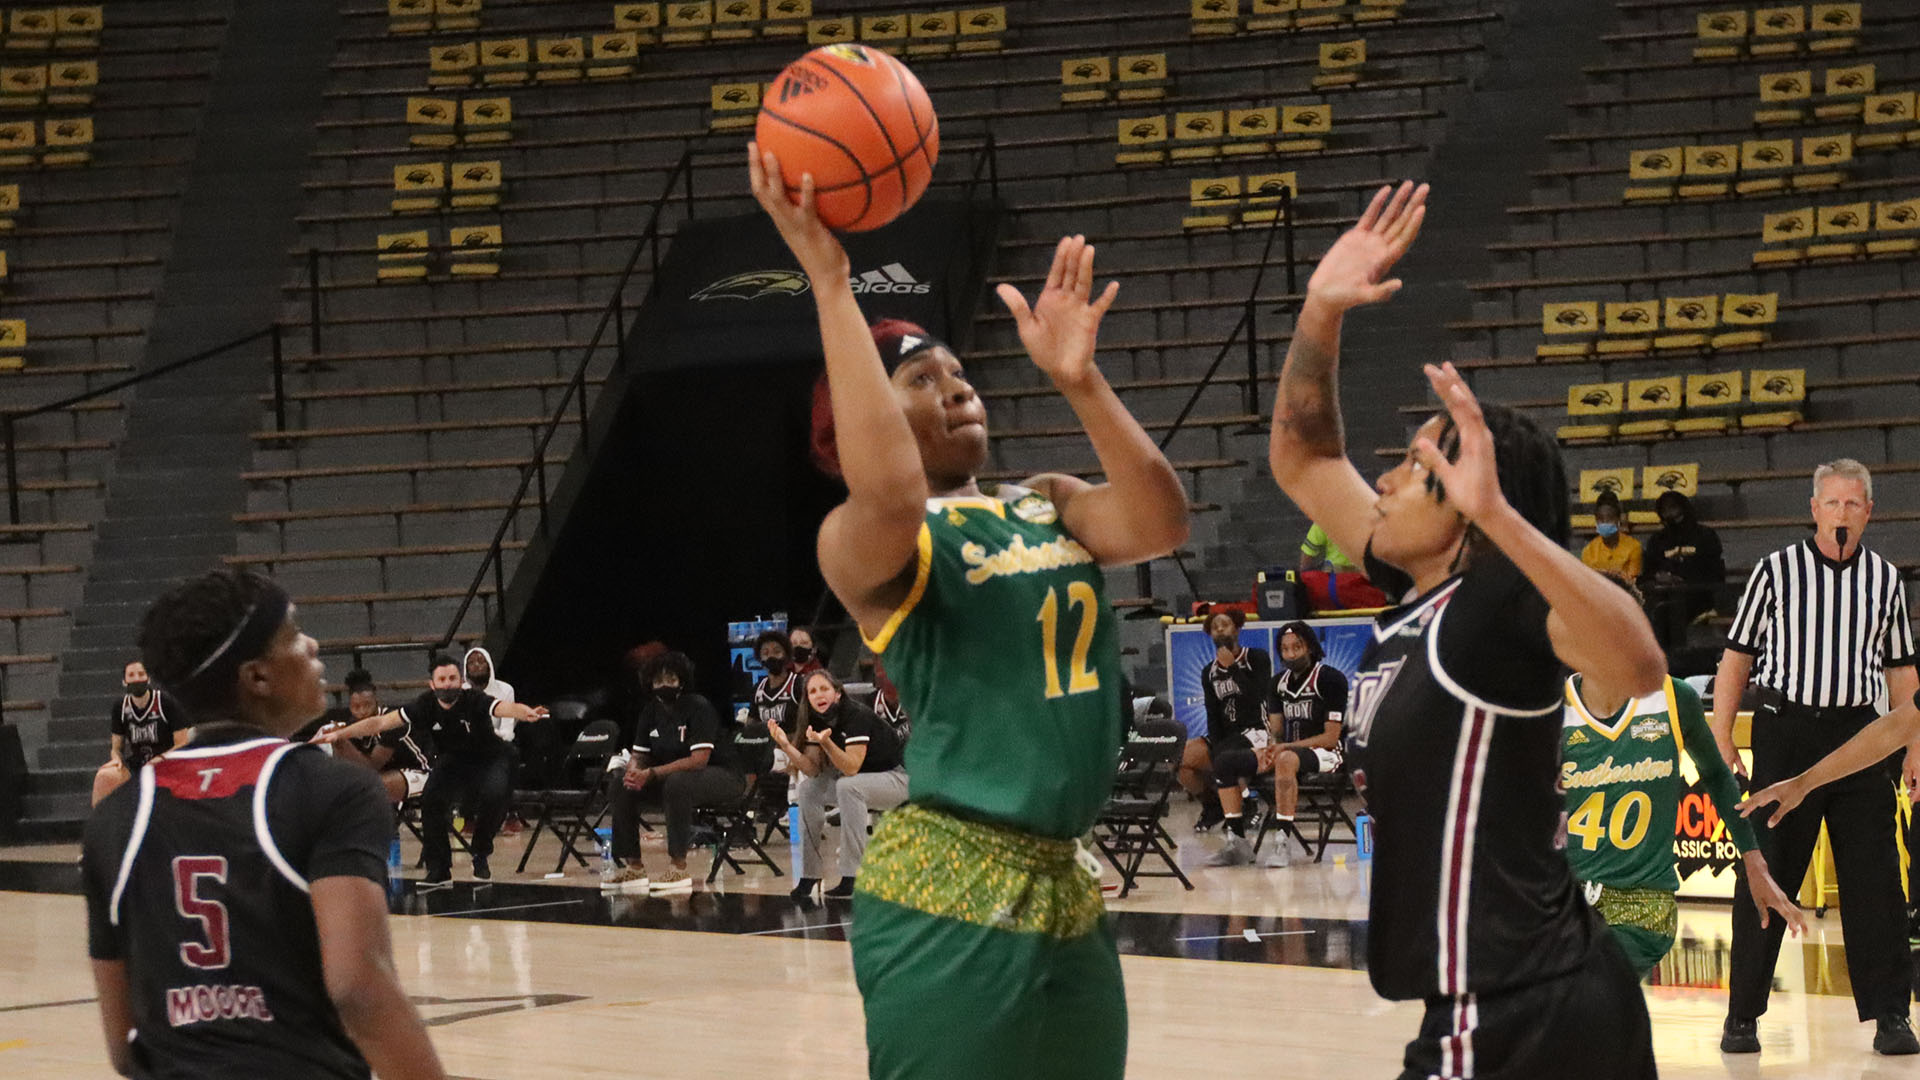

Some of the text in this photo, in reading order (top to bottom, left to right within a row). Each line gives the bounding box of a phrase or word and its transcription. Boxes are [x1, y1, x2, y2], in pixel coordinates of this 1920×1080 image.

[851, 281, 931, 294] didas
[1036, 580, 1100, 699] 12
[197, 767, 224, 792] T
[1561, 755, 1673, 789] Southeastern
[1567, 790, 1653, 851] 40
[1715, 842, 1742, 860] RO
[172, 855, 231, 970] 5
[166, 985, 275, 1028] MOORE
